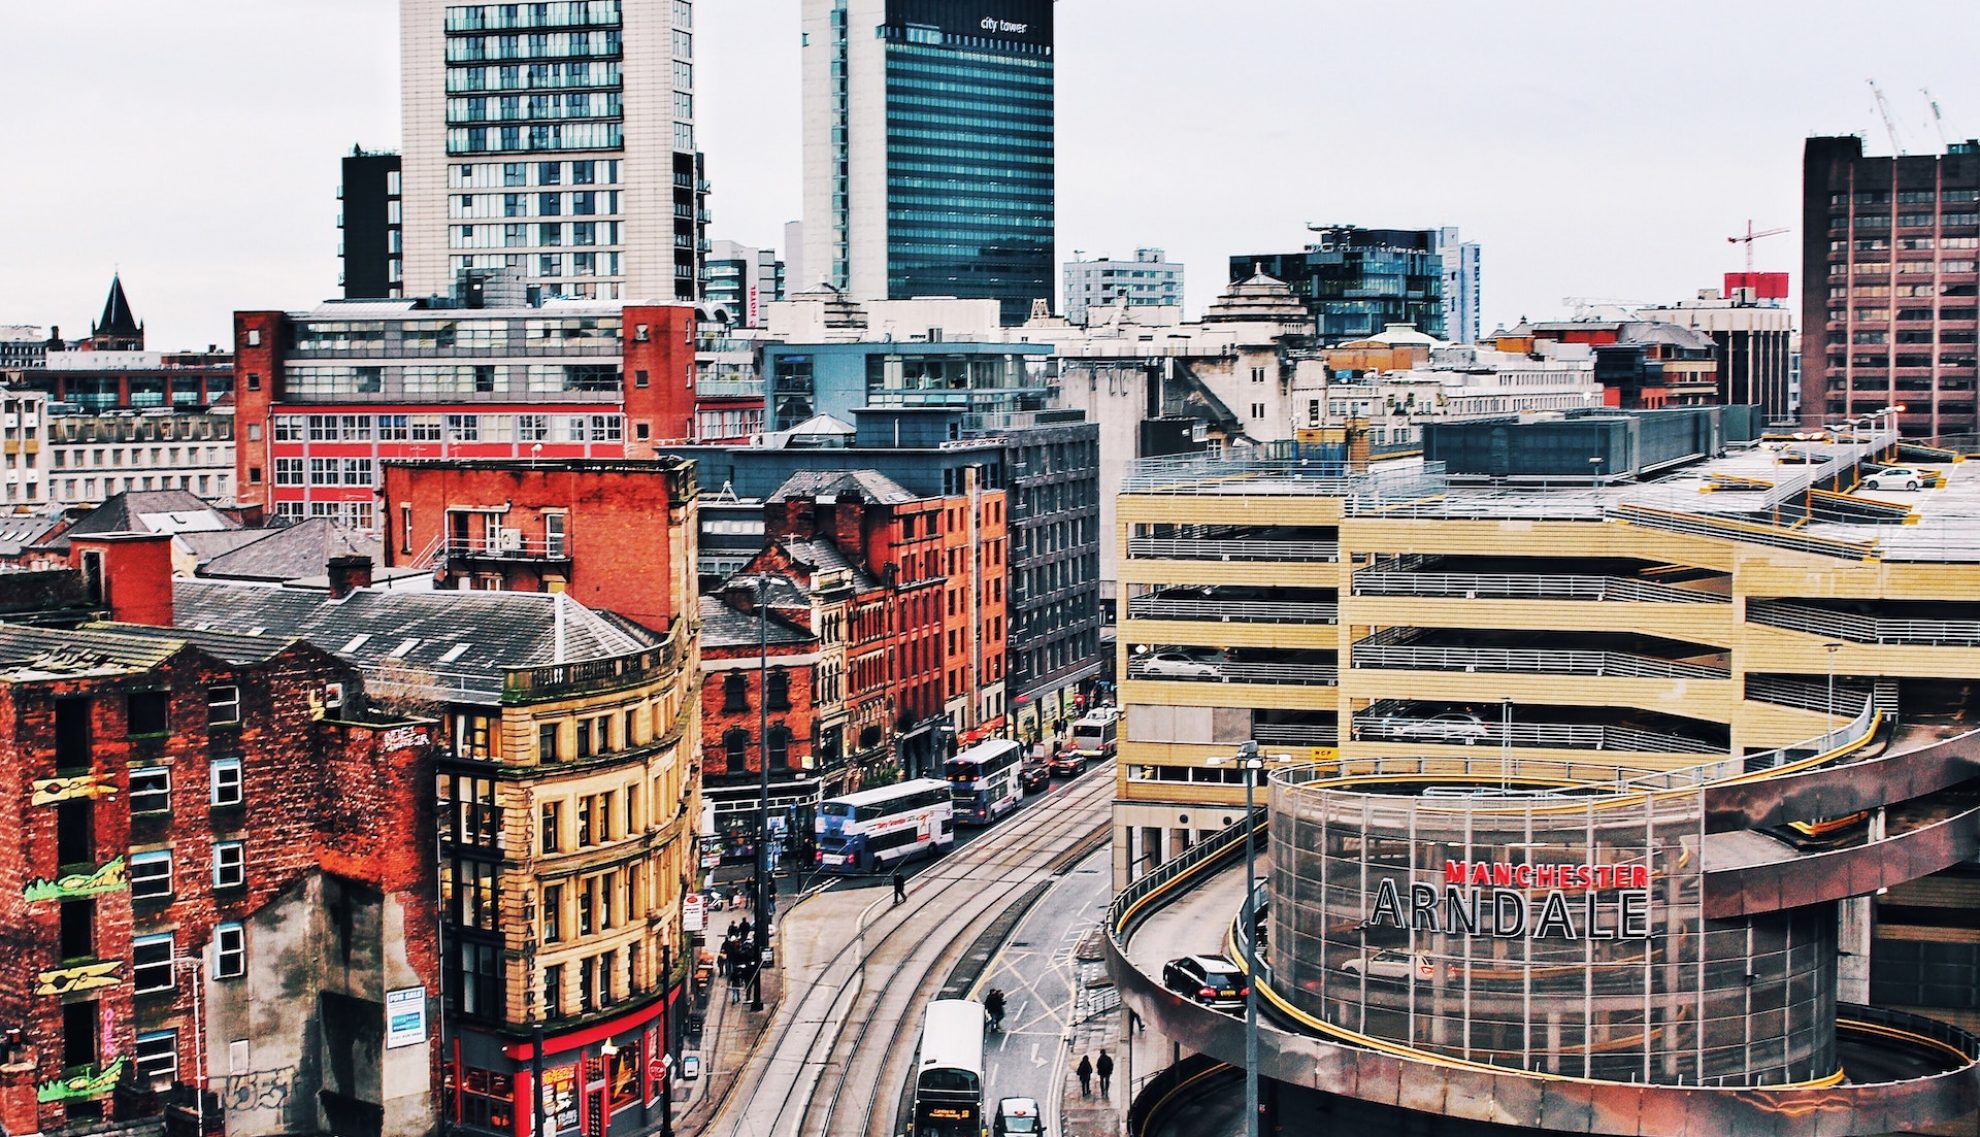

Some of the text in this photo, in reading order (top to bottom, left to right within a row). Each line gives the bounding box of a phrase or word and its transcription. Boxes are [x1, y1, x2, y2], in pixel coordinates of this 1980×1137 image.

[980, 16, 1028, 33] city tower
[1445, 859, 1648, 889] MANCHESTER
[1369, 877, 1649, 940] ARNDALE
[523, 888, 537, 1023] CHAMBERS
[390, 993, 404, 1003] FOR
[650, 1066, 665, 1075] STOP
